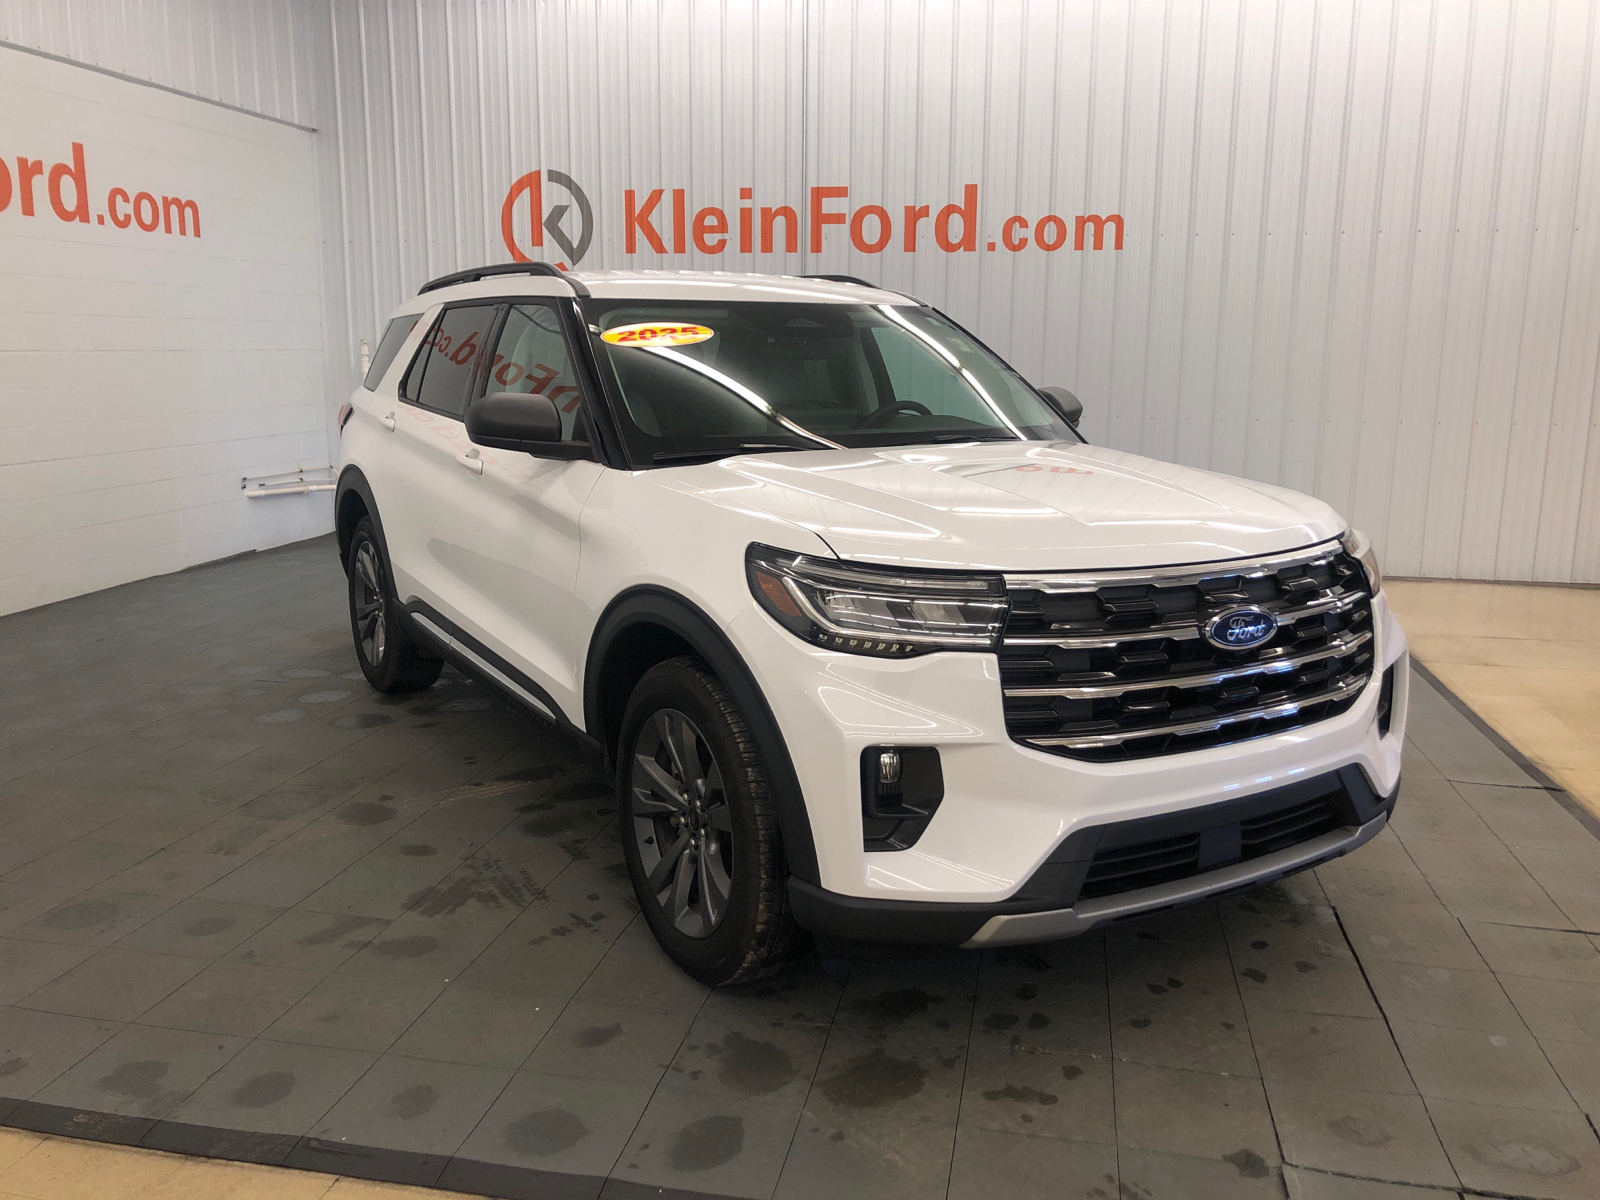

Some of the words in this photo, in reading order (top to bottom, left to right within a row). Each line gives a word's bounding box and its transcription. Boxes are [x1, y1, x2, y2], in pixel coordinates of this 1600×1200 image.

[624, 183, 1124, 255] KleinFord.com
[617, 327, 699, 342] 2025
[1227, 616, 1266, 641] Ford
